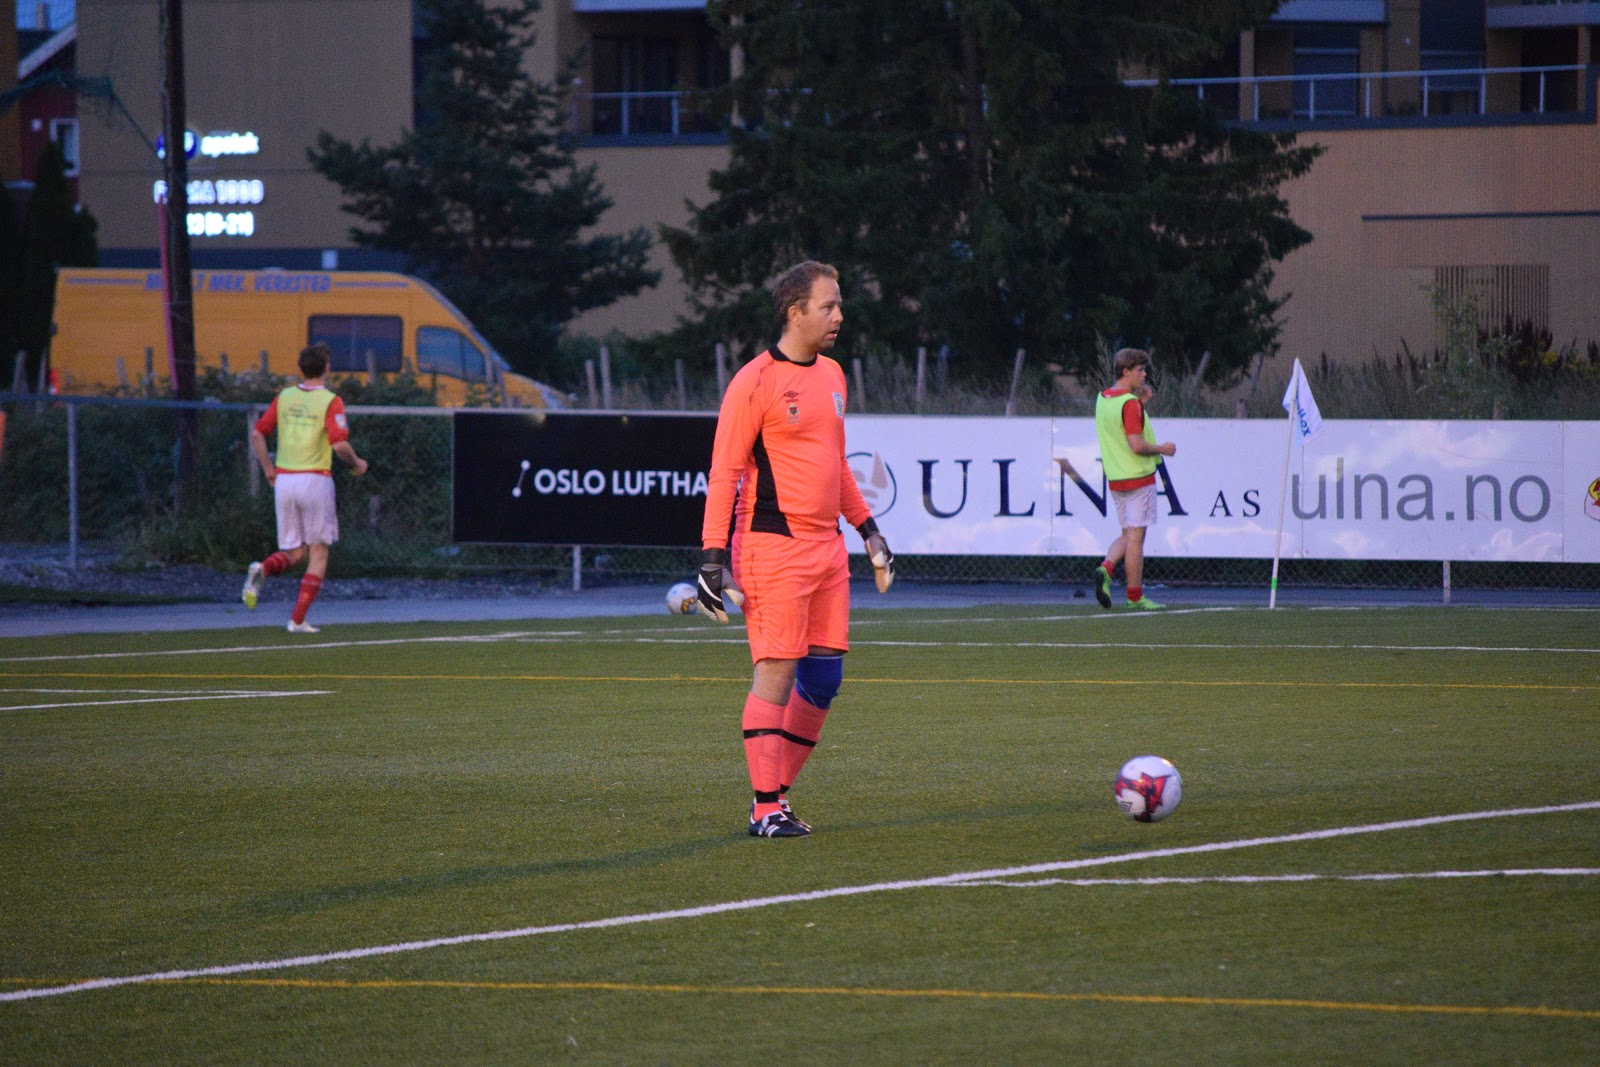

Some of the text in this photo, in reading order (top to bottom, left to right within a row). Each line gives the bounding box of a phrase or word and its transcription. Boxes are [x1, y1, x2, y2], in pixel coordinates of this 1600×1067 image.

[154, 180, 215, 203] RMA
[534, 468, 709, 496] OSLO LUFTHA
[1209, 488, 1261, 518] AS
[1291, 456, 1551, 523] ulna.no
